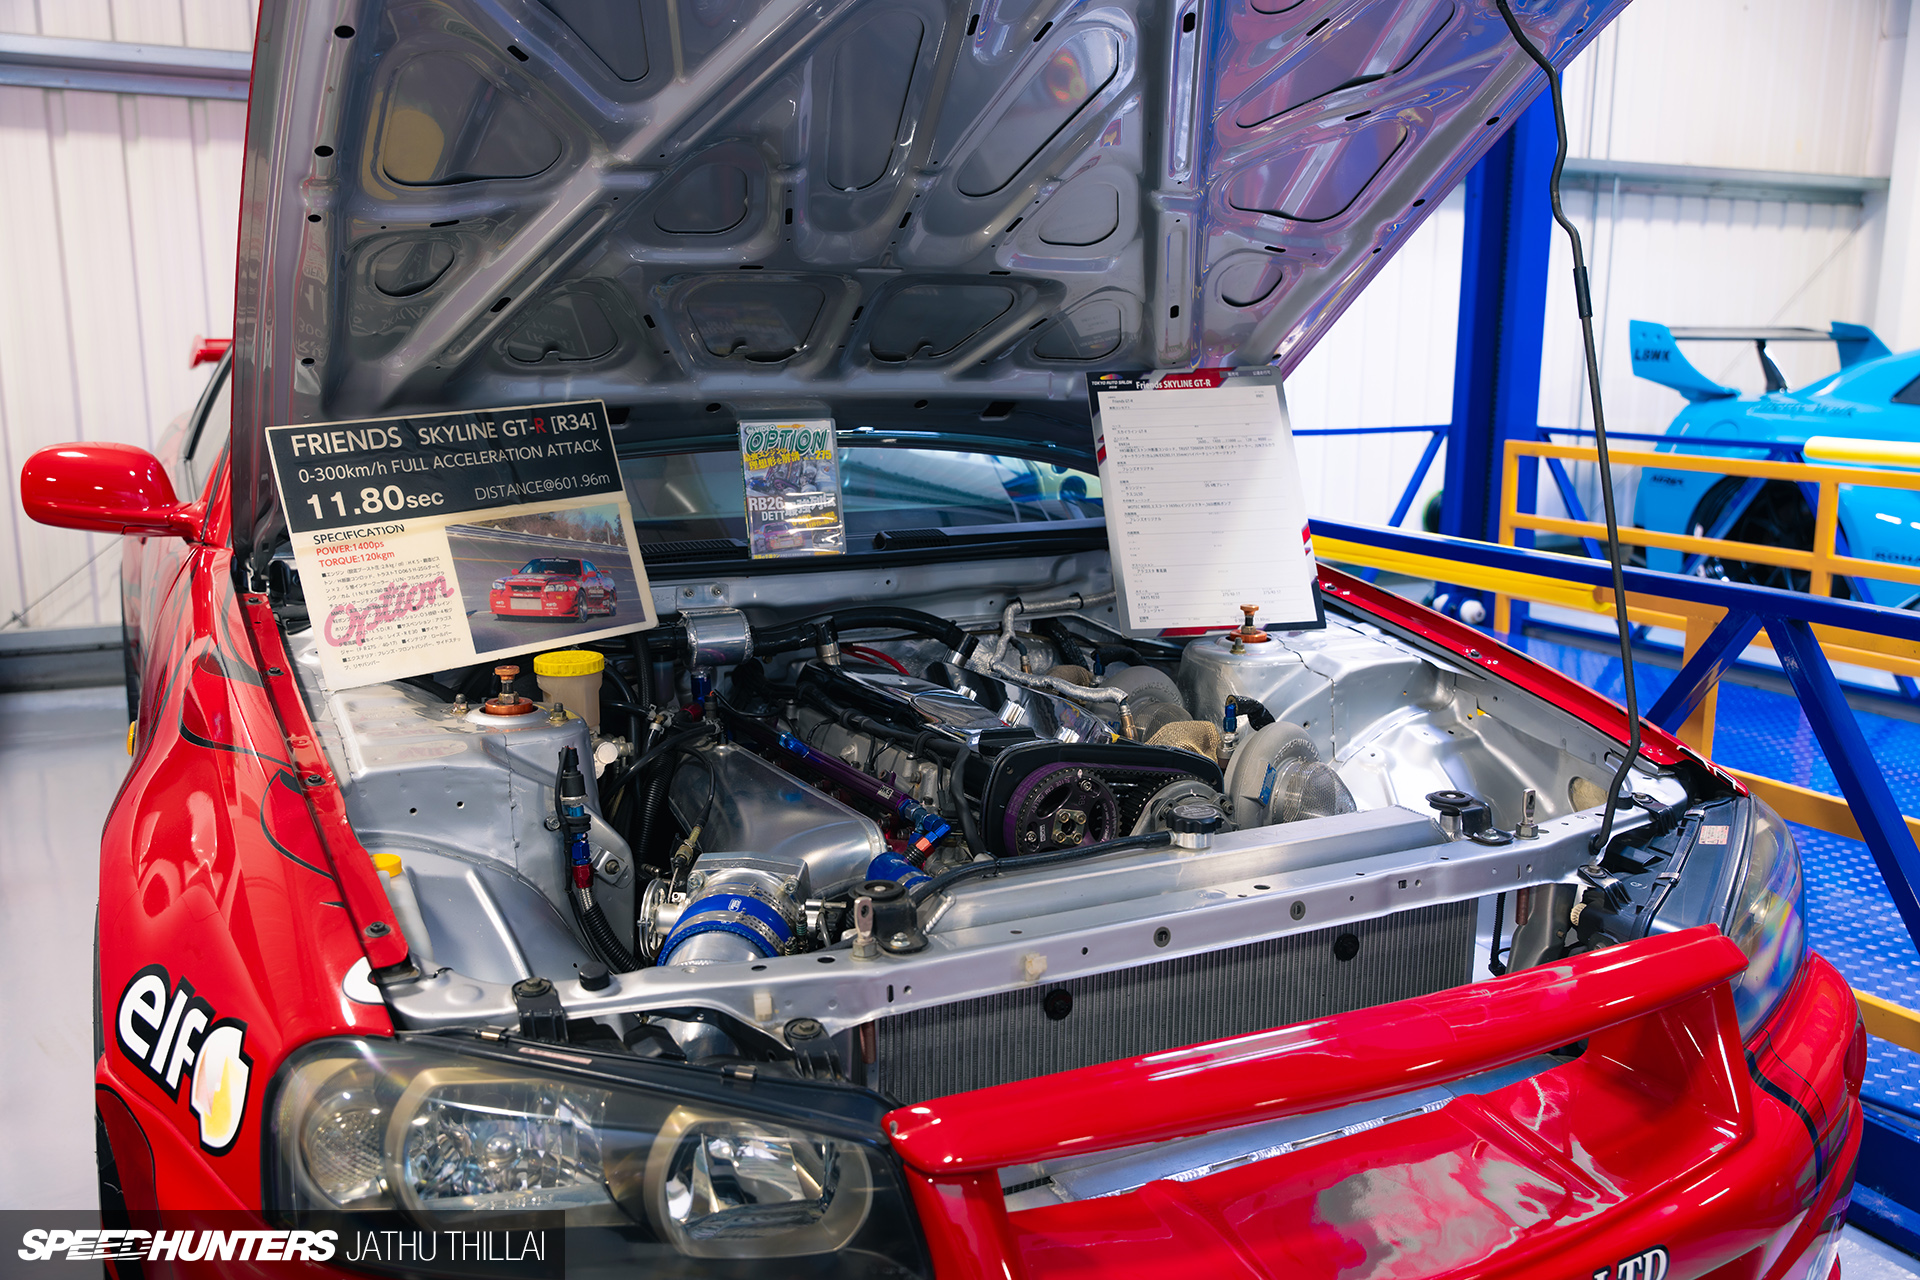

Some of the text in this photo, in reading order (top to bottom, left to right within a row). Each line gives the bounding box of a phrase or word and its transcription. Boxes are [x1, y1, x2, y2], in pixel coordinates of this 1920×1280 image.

[1135, 378, 1212, 390] Friends SKYLINE GT-R
[290, 412, 598, 457] FRIENDS SKYLINE GT-R [R34]
[745, 427, 830, 456] OPTION
[298, 438, 602, 484] 0-300km/h FULL ACCELERATION ATTACK
[815, 450, 832, 460] 275
[306, 472, 611, 521] 11.80sec DISTANCE@601.96m
[748, 497, 785, 512] RB26
[761, 510, 786, 521] DETT
[313, 523, 405, 545] SPECIFICATION
[316, 541, 385, 556] POWER:1400ps
[318, 551, 395, 568] TORQUE:120kgm
[324, 575, 455, 647] Option
[880, 786, 893, 796] HKS
[118, 973, 208, 1091] elf
[1594, 1249, 1667, 1280] TD
